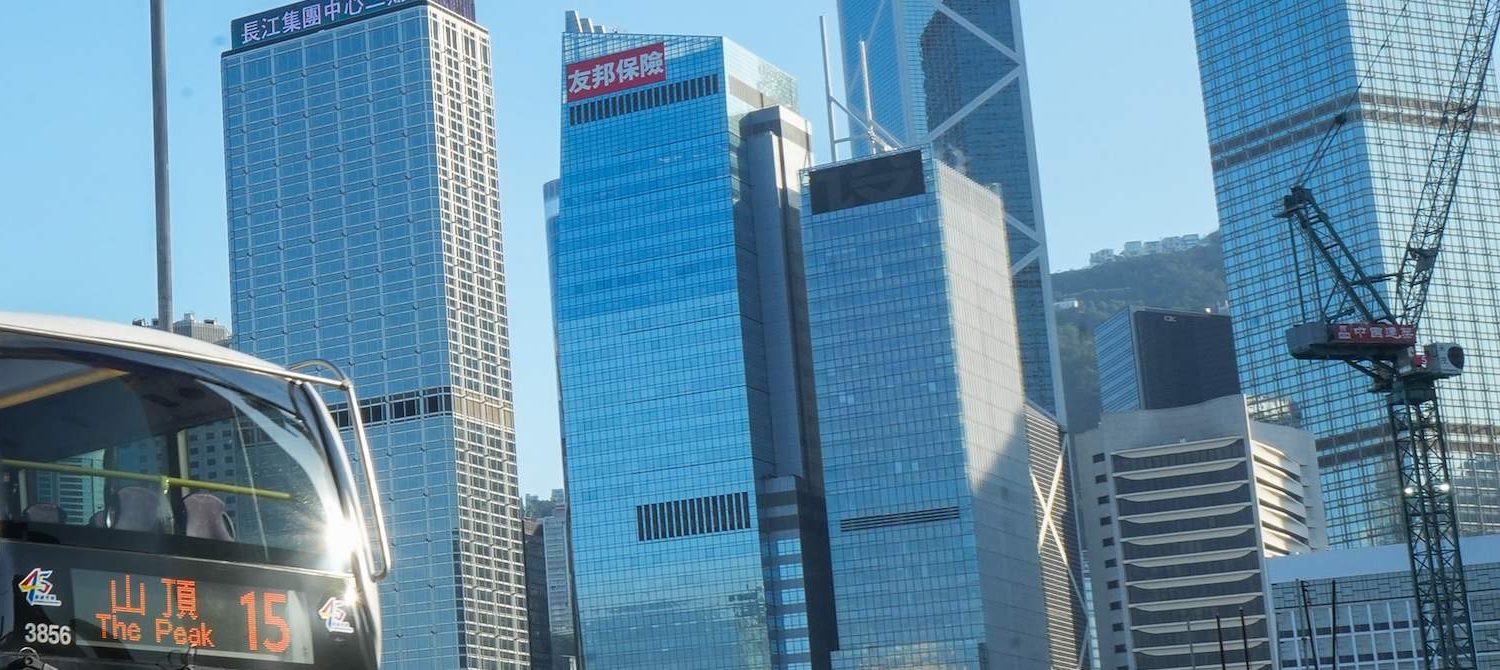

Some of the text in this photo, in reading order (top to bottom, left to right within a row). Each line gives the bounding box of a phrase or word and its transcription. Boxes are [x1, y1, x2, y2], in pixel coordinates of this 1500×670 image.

[568, 51, 664, 94] 友邦保險
[111, 574, 198, 620] 山頂
[25, 622, 72, 646] 3856
[96, 613, 216, 649] The Peak
[240, 591, 292, 653] 15
